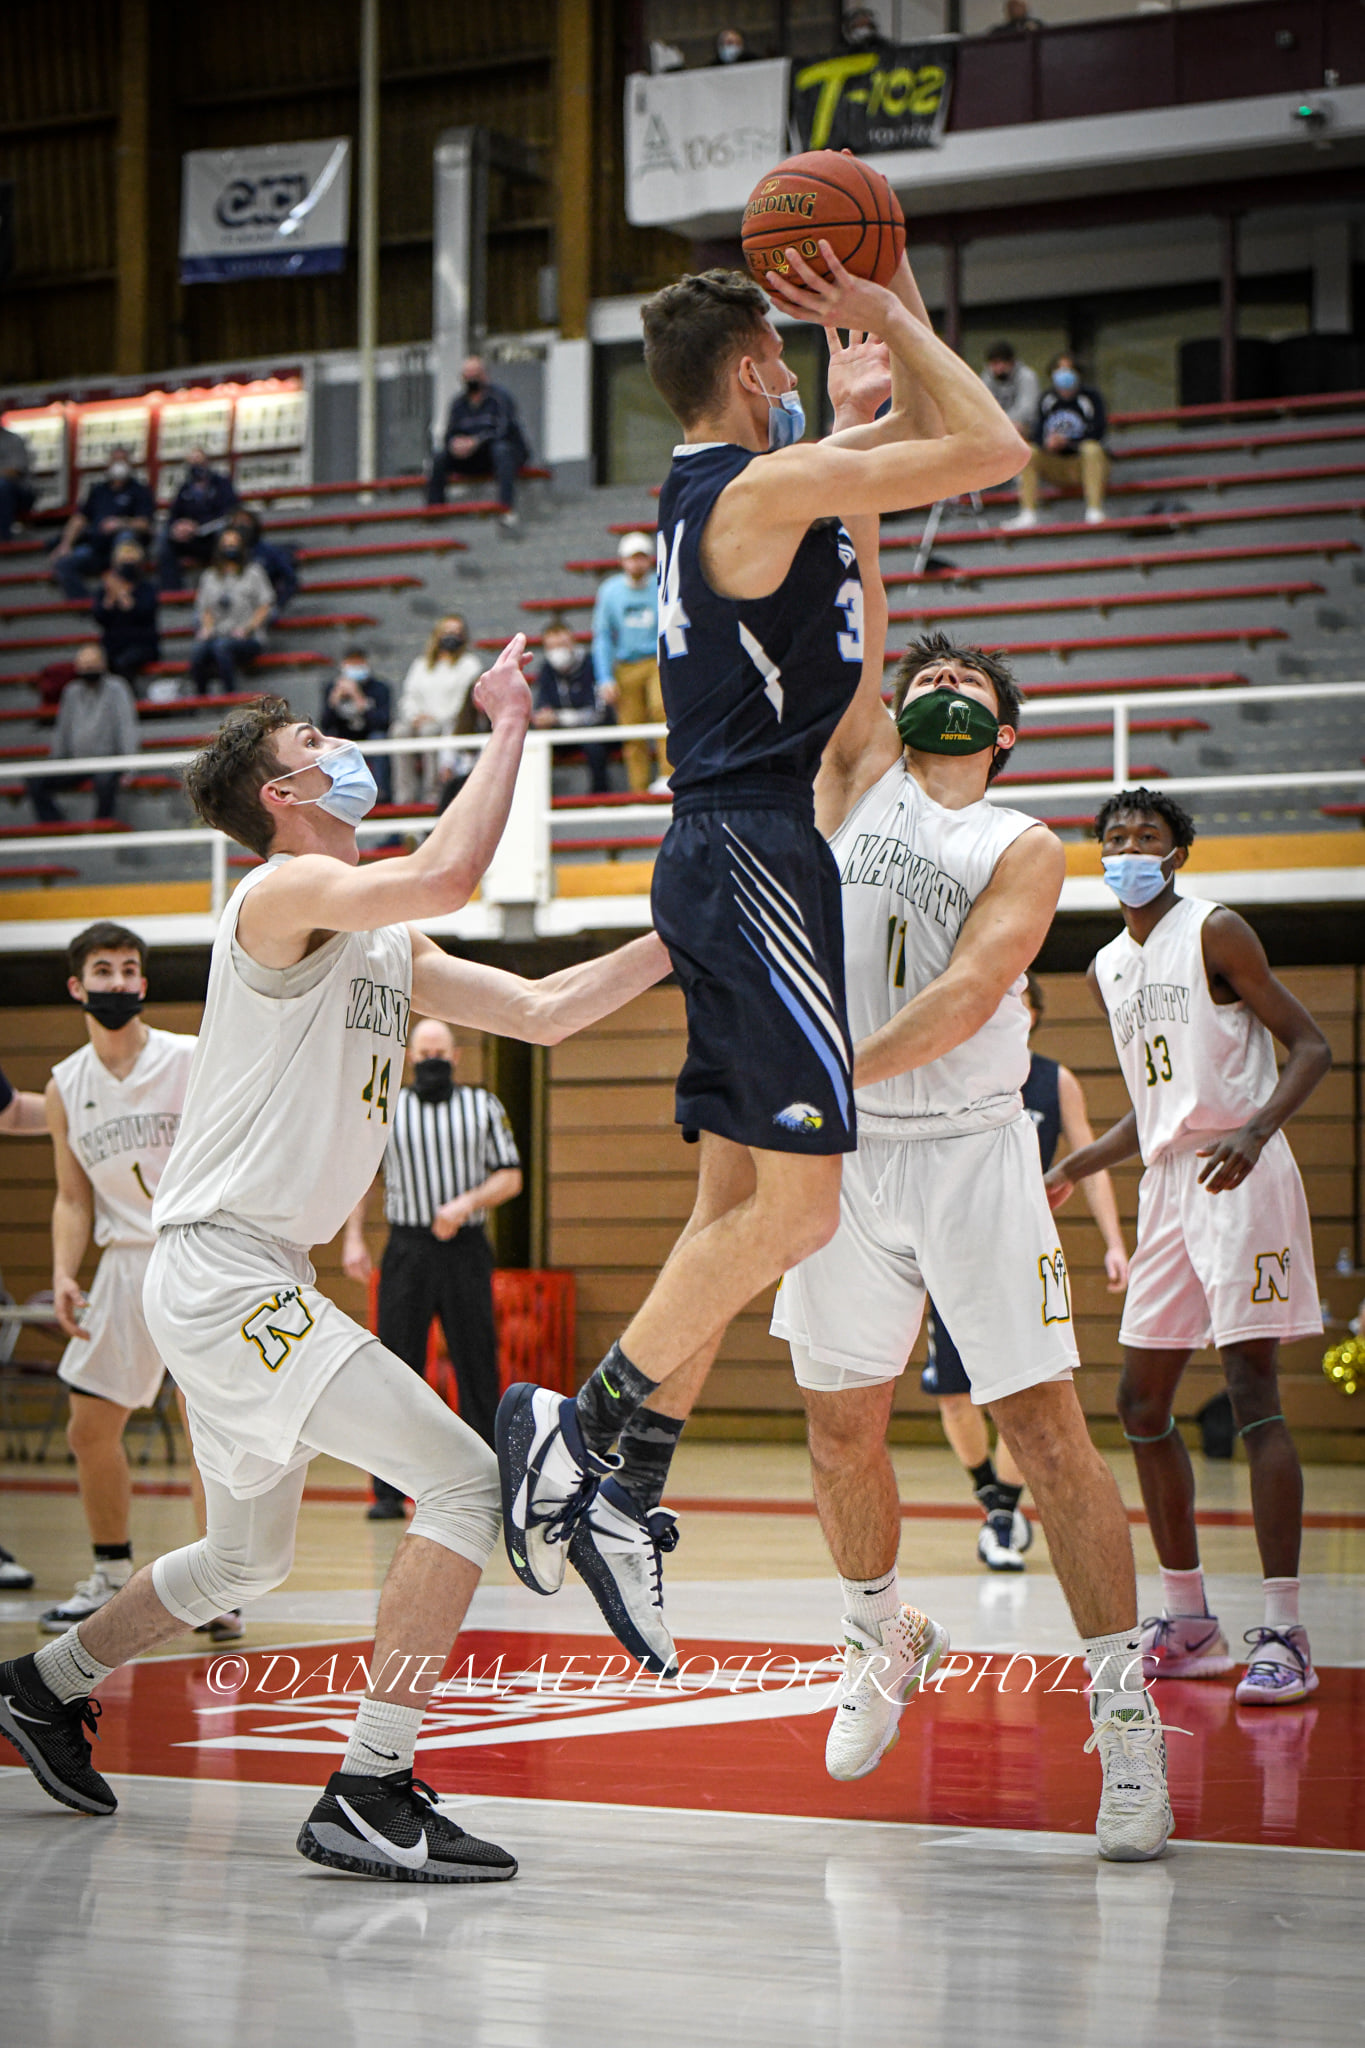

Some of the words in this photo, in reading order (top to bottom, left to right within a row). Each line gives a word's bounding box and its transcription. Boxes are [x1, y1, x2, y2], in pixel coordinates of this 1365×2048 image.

[795, 52, 946, 150] T-102
[744, 192, 817, 219] ALDING
[78, 1112, 183, 1169] NATIVIT
